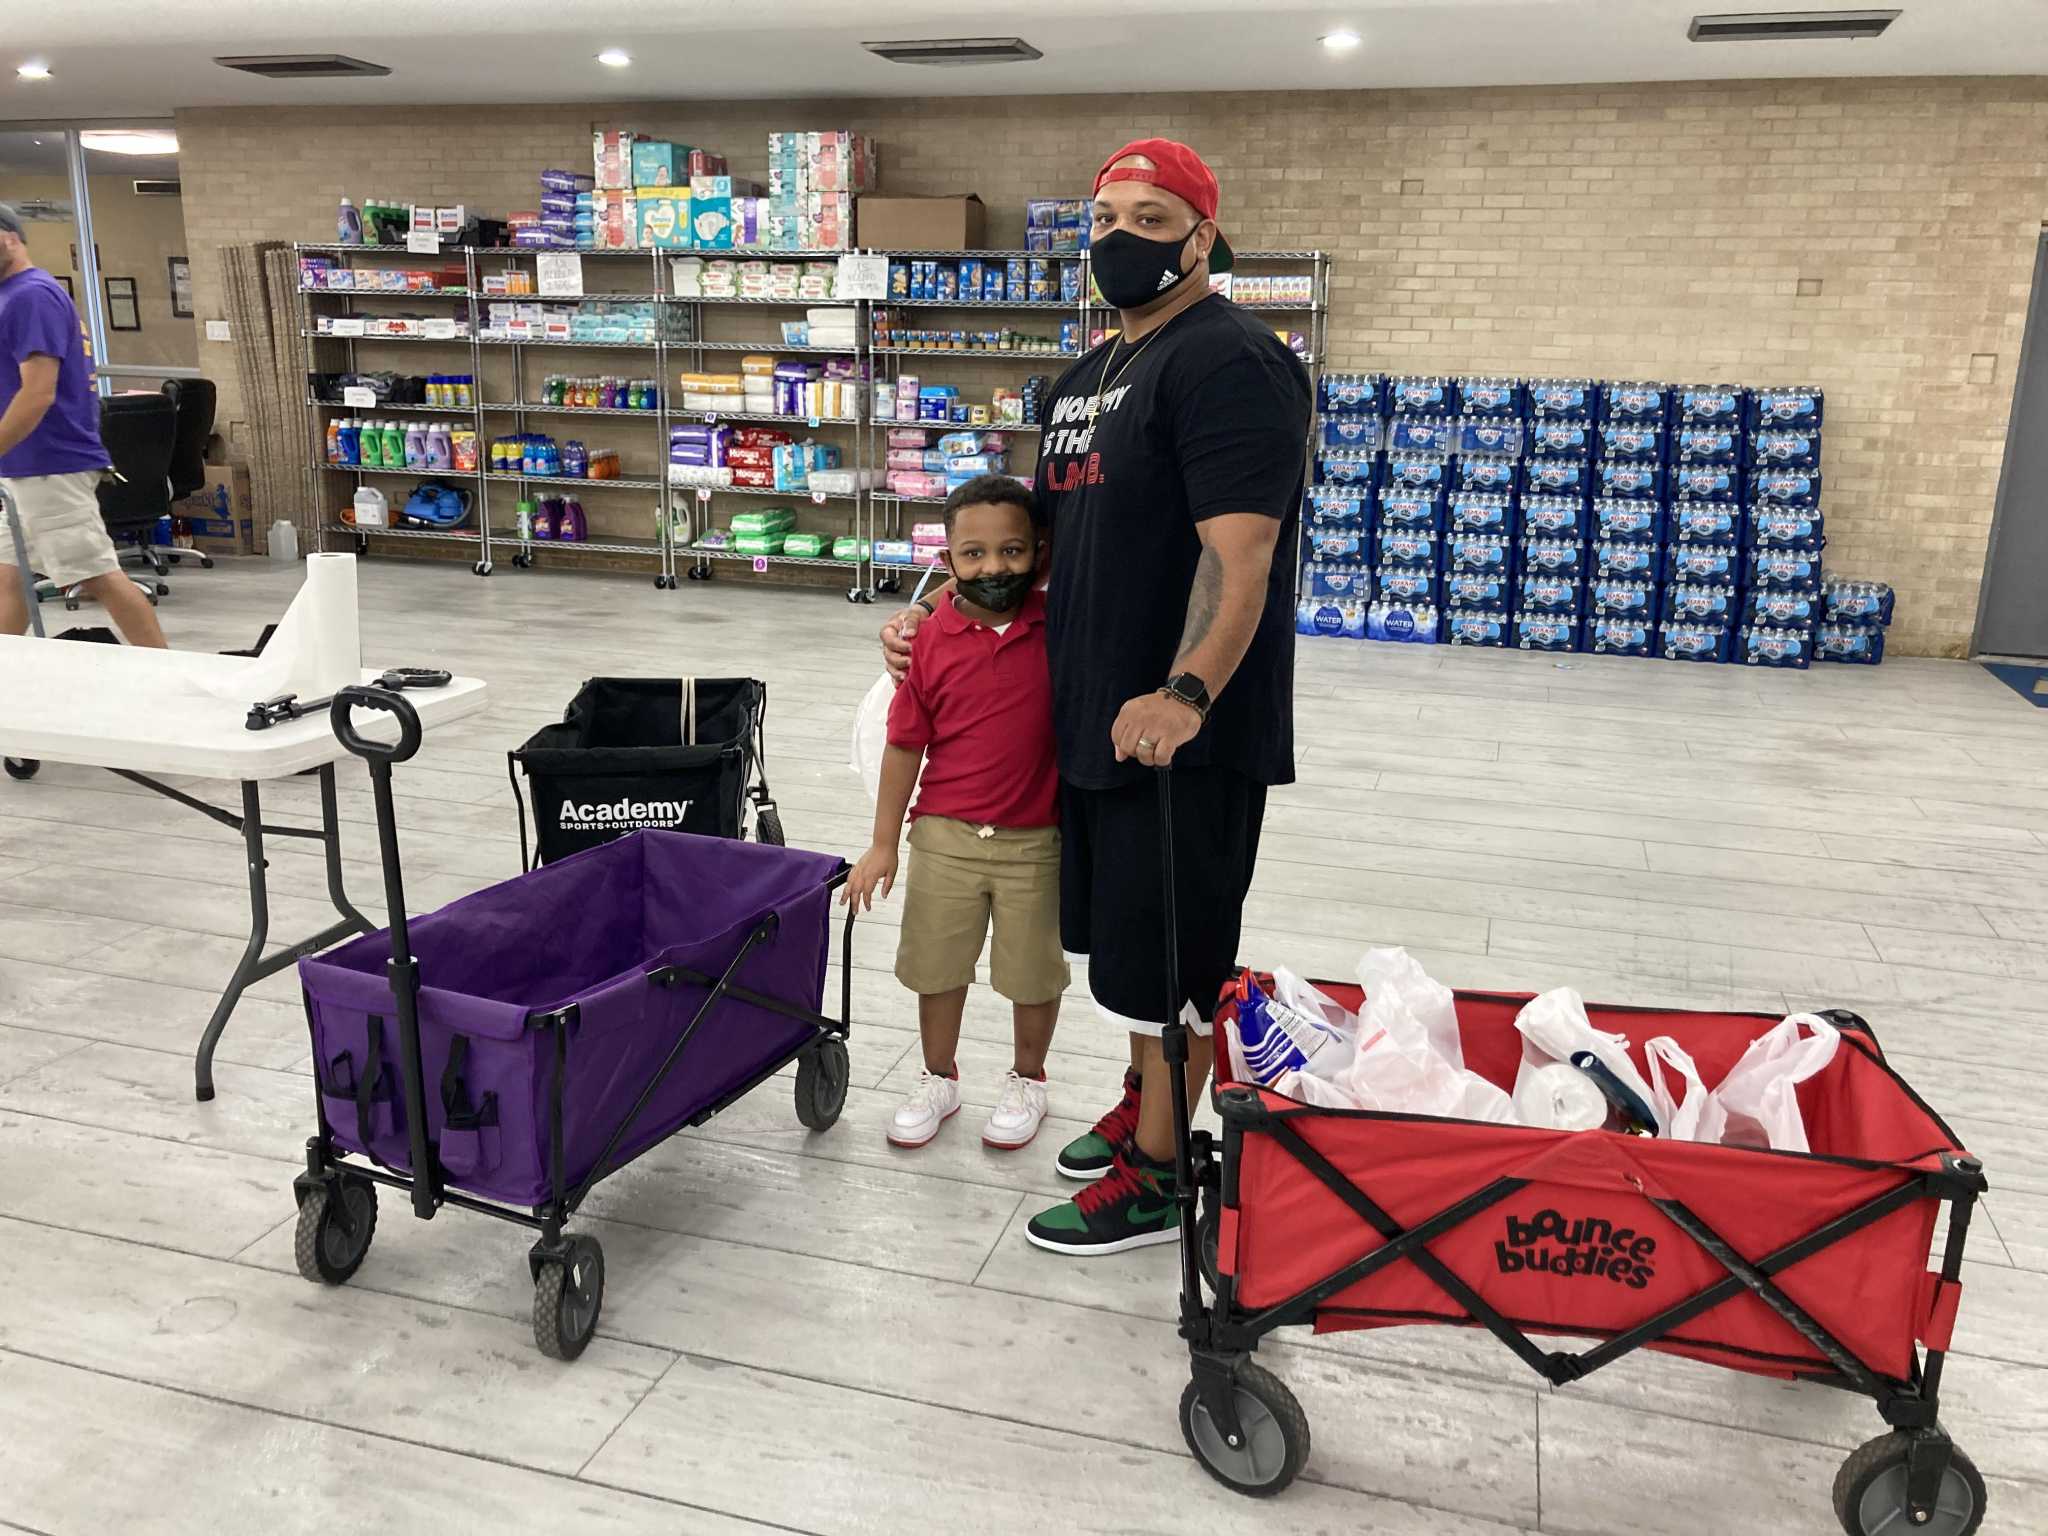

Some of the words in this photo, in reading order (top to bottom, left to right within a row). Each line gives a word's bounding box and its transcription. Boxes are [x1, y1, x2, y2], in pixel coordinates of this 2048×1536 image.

[1051, 384, 1132, 425] WORHY
[1315, 615, 1342, 624] WATER
[1386, 619, 1414, 628] WATER
[559, 797, 689, 825] Academy
[560, 820, 675, 830] SPORTS+OUTDOORS
[1506, 1208, 1656, 1264] bounce
[1494, 1240, 1655, 1289] buddies
